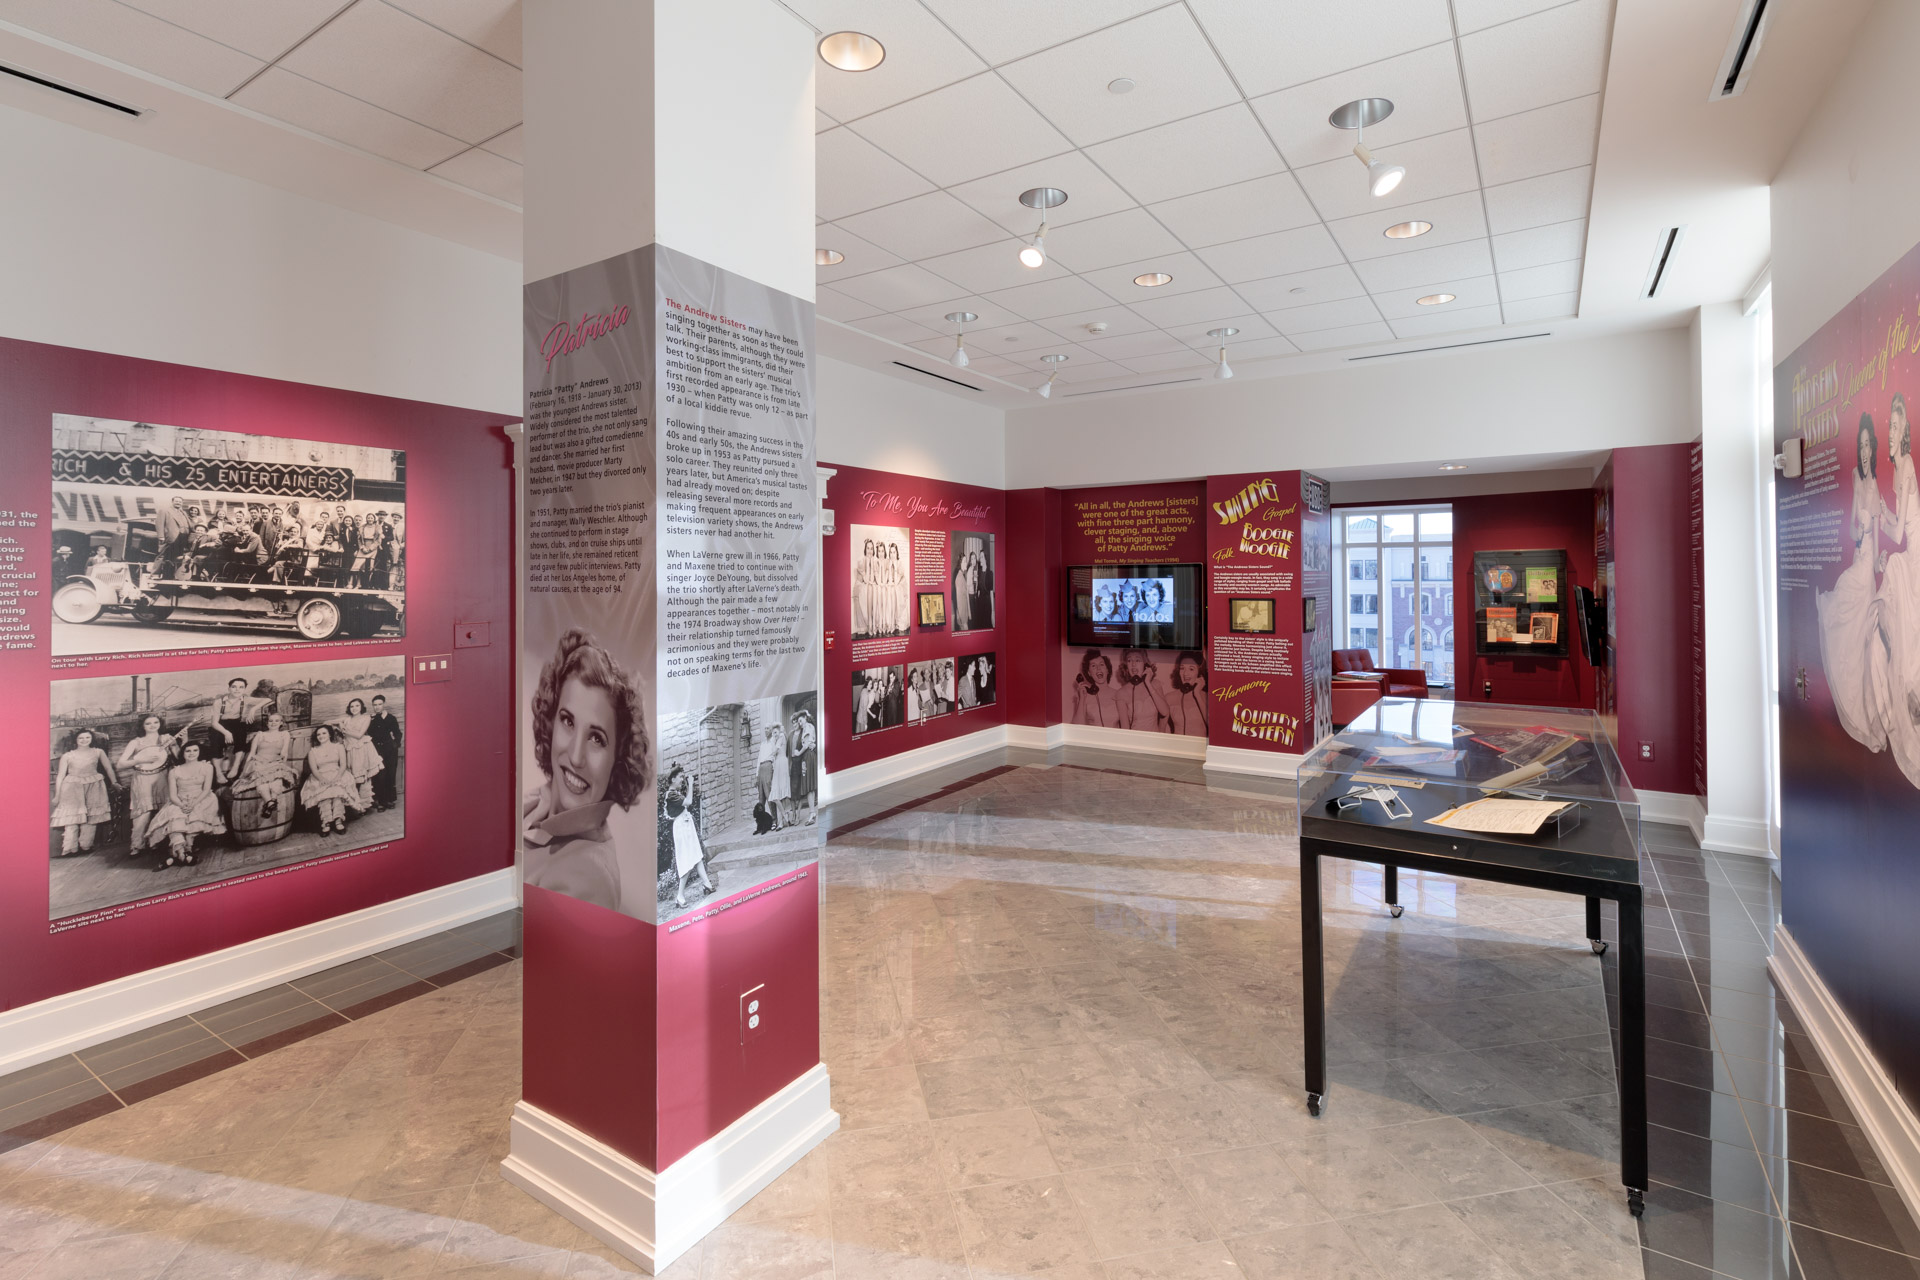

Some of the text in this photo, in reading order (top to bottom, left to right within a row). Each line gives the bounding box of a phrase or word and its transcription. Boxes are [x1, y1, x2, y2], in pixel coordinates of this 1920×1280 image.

[666, 298, 798, 346] The Andrew Sisters may have been
[540, 304, 631, 374] Patricia
[666, 311, 695, 327] singing
[698, 321, 730, 336] together
[742, 334, 759, 345] soon
[770, 342, 784, 354] they
[787, 347, 804, 358] could
[666, 323, 805, 369] talk. Their parents, although they were
[666, 335, 794, 376] working-class immigrants, did their
[666, 346, 683, 357] best
[686, 352, 694, 361] to
[696, 355, 726, 369] support
[728, 362, 740, 372] the
[768, 374, 792, 385] musical
[1842, 314, 1909, 412] Queens of the
[666, 359, 702, 374] ambition
[704, 368, 722, 379] from
[724, 372, 733, 381] an
[735, 376, 753, 387] early
[755, 381, 769, 391] age.
[771, 384, 783, 394] The
[530, 389, 552, 399] Patricia
[580, 377, 609, 389] Andrews
[666, 370, 801, 408] first recorded appearance is from late
[1792, 360, 1838, 432] ANDREWS
[543, 410, 551, 418] the
[553, 406, 580, 418] youngest
[581, 400, 608, 411] Andrews
[1804, 404, 1839, 450] SISTERS
[119, 462, 132, 476] &
[145, 464, 170, 478] HIS
[185, 467, 206, 481] 25
[218, 469, 339, 490] ENTERTAINERS
[907, 495, 928, 518] You
[929, 500, 948, 517] Are
[1090, 502, 1098, 510] in
[1100, 501, 1110, 510] all,
[1128, 500, 1164, 508] Andrews
[1166, 496, 1198, 506] [sisters]
[1131, 508, 1144, 516] the
[1146, 508, 1168, 517] great
[1171, 507, 1189, 515] acts,
[1213, 478, 1279, 525] SWING
[1263, 503, 1297, 522] Gospel
[1108, 527, 1140, 536] staging,
[1142, 526, 1160, 534] and,
[1114, 518, 1134, 526] three
[1136, 518, 1153, 526] part
[1156, 516, 1195, 524] harmony,
[1095, 536, 1106, 544] all,
[1123, 536, 1152, 544] singing
[1154, 534, 1176, 542] voice
[1243, 522, 1294, 544] BOOGIE
[667, 550, 690, 558] When
[693, 551, 723, 559] LaVerne
[725, 553, 744, 561] grew
[763, 552, 780, 561] 1966,
[783, 554, 799, 562] Patty
[1098, 544, 1105, 552] of
[1108, 545, 1128, 553] Patty
[1213, 547, 1235, 563] Folk
[1239, 538, 1291, 559] WOOGIE
[778, 563, 793, 571] with
[667, 574, 692, 584] singer
[694, 574, 715, 583] Joyce
[717, 574, 751, 583] DeYoung,
[1135, 612, 1169, 622] 1940s
[1212, 680, 1271, 701] Harmony
[1234, 702, 1299, 730] COUNTRY
[1232, 720, 1294, 746] WESTERN
